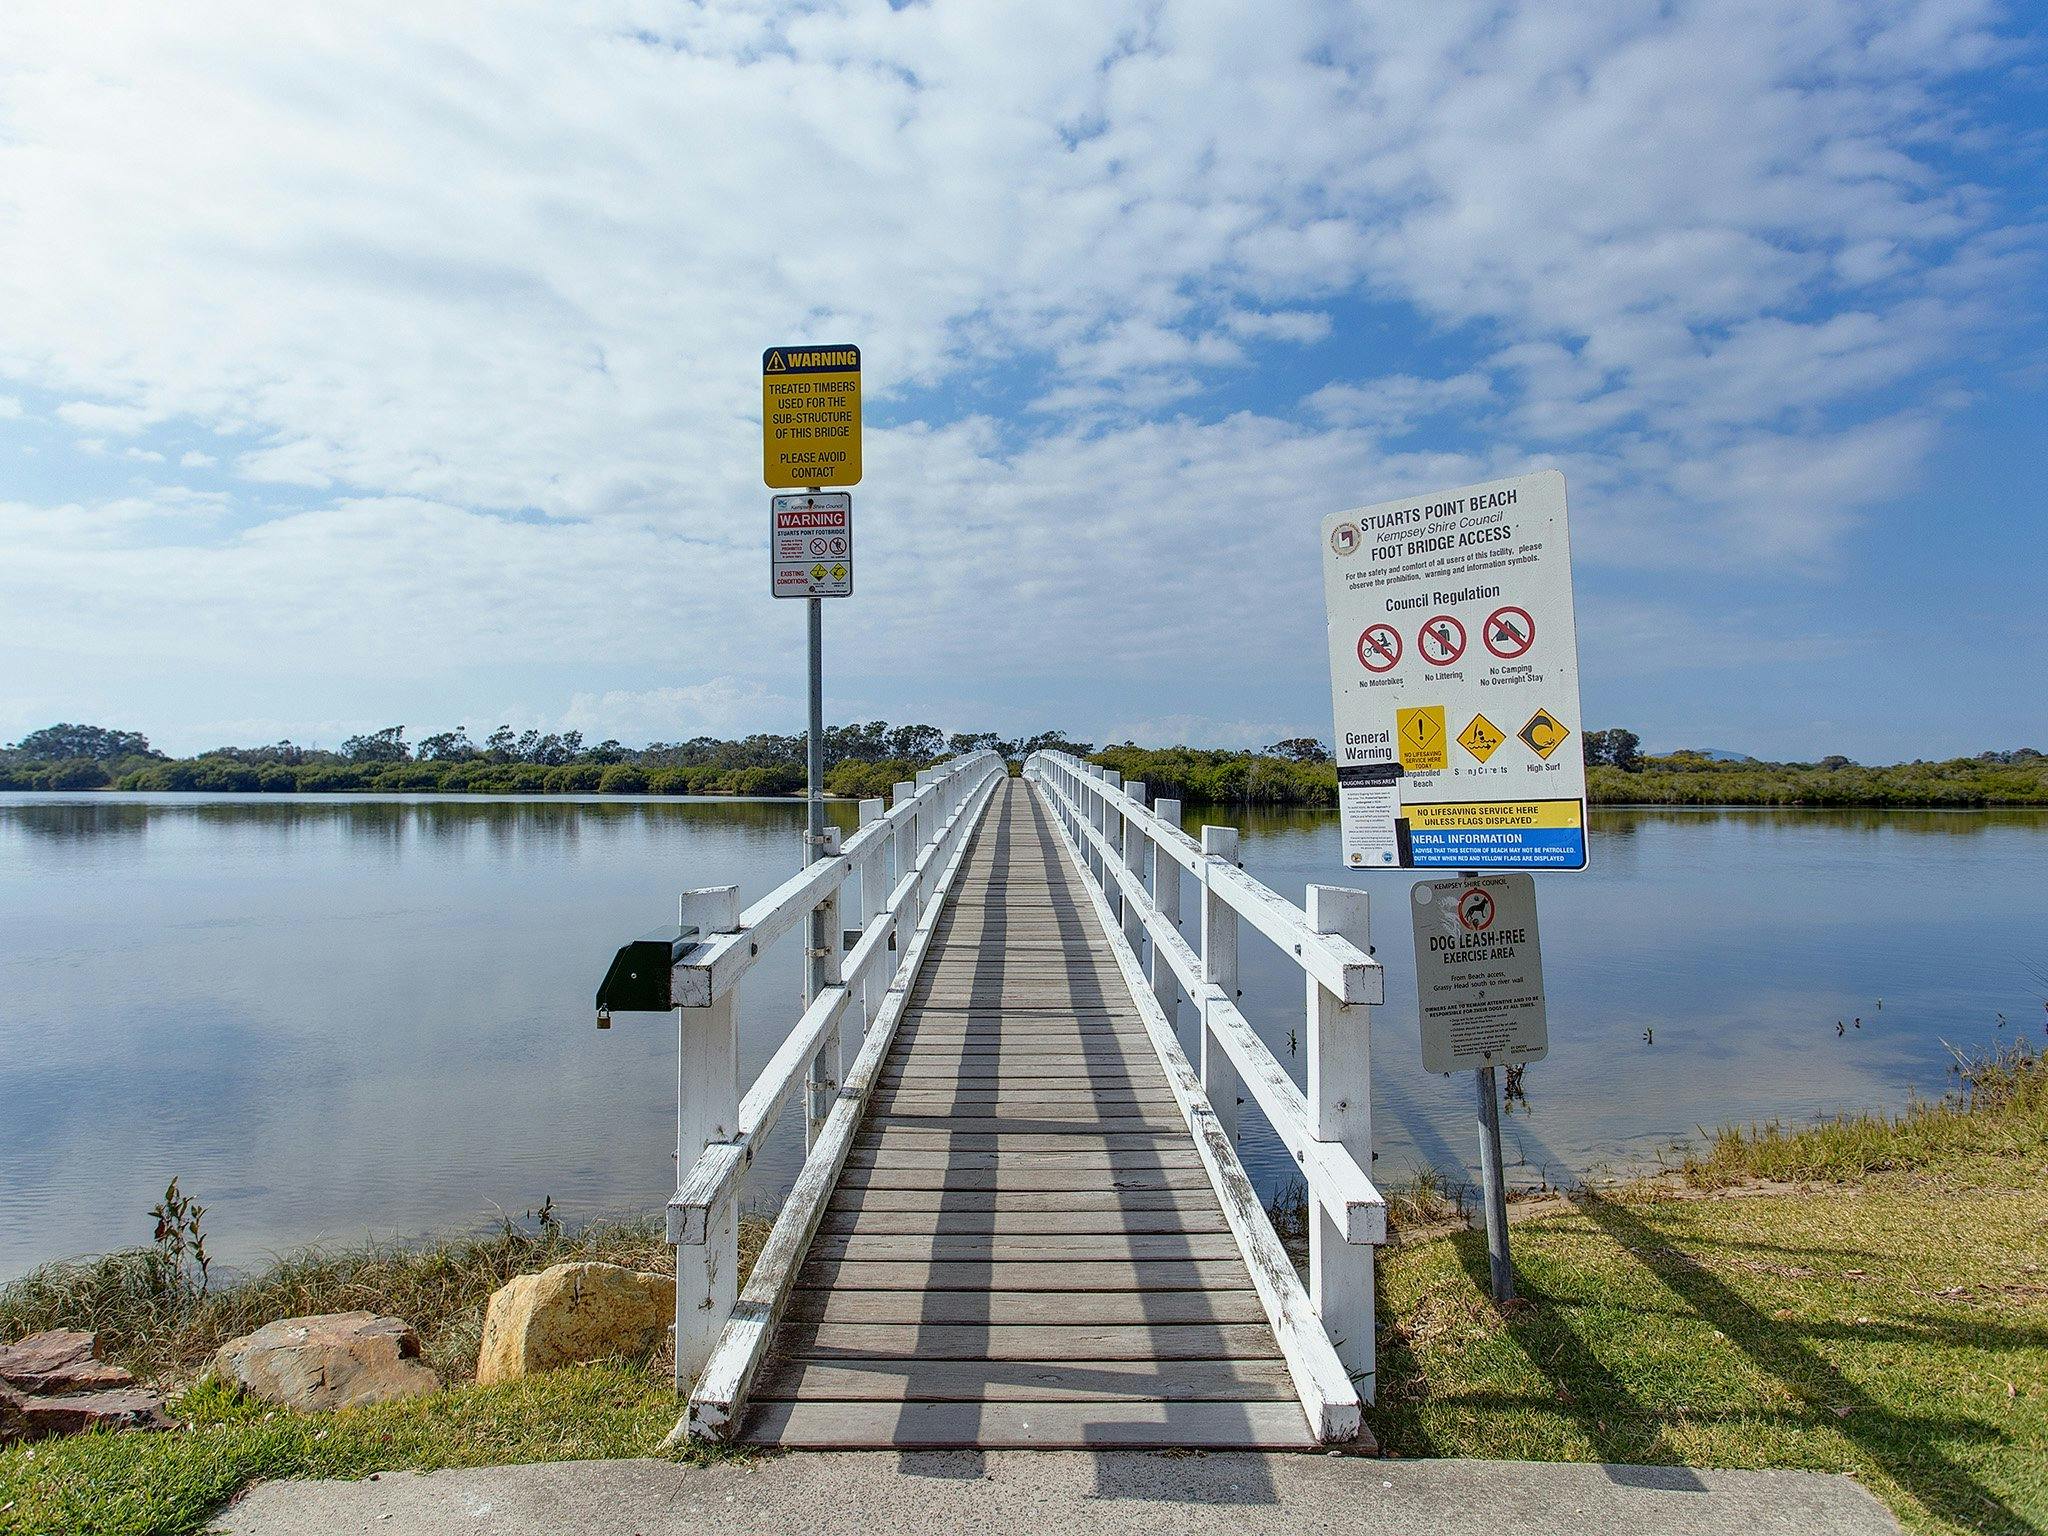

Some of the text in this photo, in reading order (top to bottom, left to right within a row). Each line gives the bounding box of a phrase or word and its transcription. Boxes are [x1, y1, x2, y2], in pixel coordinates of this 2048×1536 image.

[787, 351, 857, 368] WARNING
[769, 382, 856, 394] TREATED TIMBERS
[778, 396, 846, 409] USED FOR THE
[772, 411, 852, 424] SUB-STRUCTURE
[776, 426, 850, 439] OF THIS BRIDGE
[780, 451, 846, 464] PLEASE AVOID
[791, 466, 835, 478] CONTACT
[1361, 489, 1517, 532] STUARTS POINT BEACH
[780, 513, 843, 527] WARNING
[1376, 526, 1426, 543] Kempsey
[1428, 520, 1456, 534] Shire
[1460, 510, 1504, 528] Council
[1372, 525, 1511, 561] FOOT BRIDGE ACCESS
[1346, 572, 1356, 580] For
[1368, 568, 1388, 578] safety
[1389, 566, 1400, 574] and
[1402, 560, 1428, 572] comfort
[1428, 559, 1436, 567] of
[1446, 555, 1465, 564] users
[1466, 552, 1474, 560] of
[1475, 550, 1488, 560] this
[1518, 542, 1542, 554] please
[1349, 581, 1374, 590] observe
[1424, 568, 1450, 578] warning
[1452, 565, 1464, 574] and
[1466, 560, 1506, 572] information
[1508, 554, 1540, 566] symbols.
[1386, 585, 1500, 612] Council Regulation
[1436, 671, 1462, 680] Littering
[1502, 664, 1532, 674] Camping
[1370, 677, 1404, 686] Motorbikes
[1492, 675, 1526, 685] Overnight
[1528, 674, 1544, 682] Stay
[1346, 730, 1390, 745] General
[1345, 746, 1392, 760] Warning
[1526, 762, 1560, 774] High Surf
[1414, 780, 1434, 788] Beach
[1418, 808, 1428, 816] NO
[1430, 808, 1476, 816] LIFESAVING
[1478, 806, 1514, 815] SERVICE
[1486, 816, 1532, 824] DISPLAYED
[1412, 834, 1522, 844] NERAL INFORMATION
[1430, 928, 1526, 952] DOG LEASH-FREE
[1444, 946, 1515, 964] EXERCISE AREA
